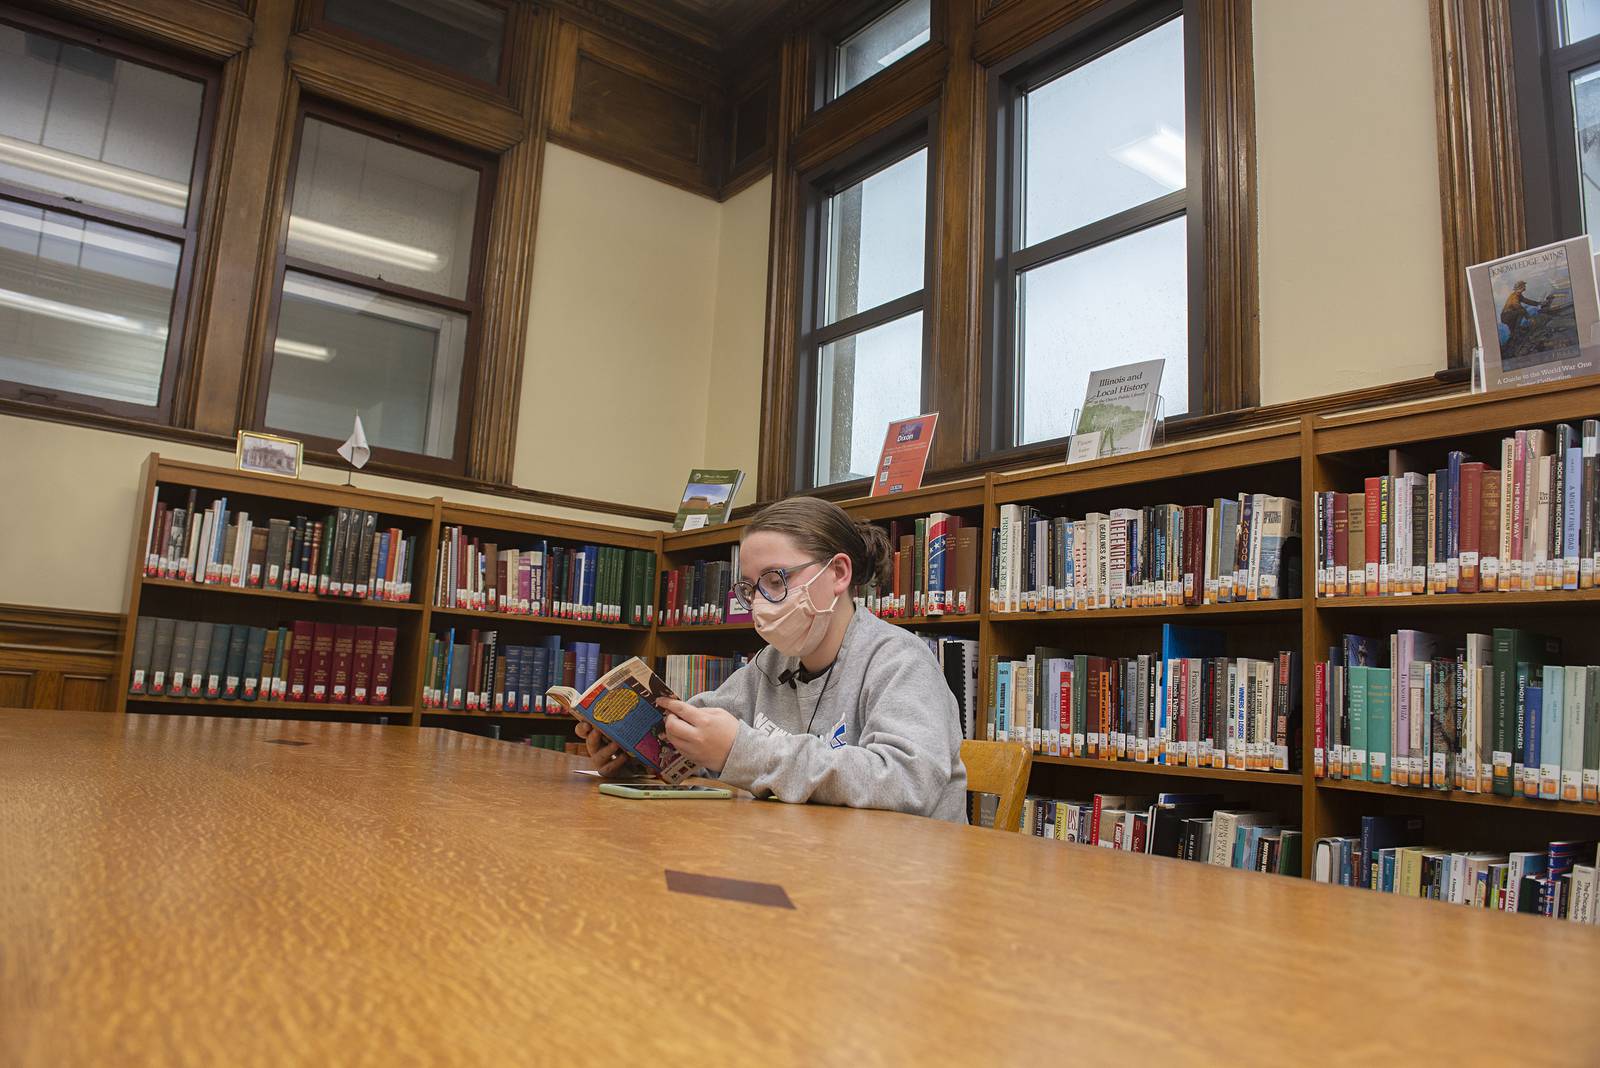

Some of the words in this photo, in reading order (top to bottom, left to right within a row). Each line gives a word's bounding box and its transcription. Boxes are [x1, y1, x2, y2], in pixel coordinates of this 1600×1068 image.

[1491, 256, 1539, 275] KNOWLEDGE
[1542, 249, 1564, 262] WINS
[1099, 375, 1126, 387] Illinois
[1127, 372, 1143, 381] and
[1541, 366, 1561, 376] World
[1561, 365, 1576, 373] War
[1577, 361, 1592, 369] One
[1096, 386, 1118, 397] Local
[1119, 382, 1149, 394] History
[897, 434, 914, 442] Dixon
[1001, 517, 1009, 554] PRINTED
[1110, 519, 1126, 570] DEFENDER
[1191, 670, 1199, 697] Frances
[1216, 687, 1221, 696] TO
[1315, 665, 1323, 696] Christmas
[1191, 697, 1199, 724] Willard
[1315, 704, 1323, 725] Illinois
[1215, 817, 1224, 865] COMPANY
[1581, 892, 1589, 914] Chicago
